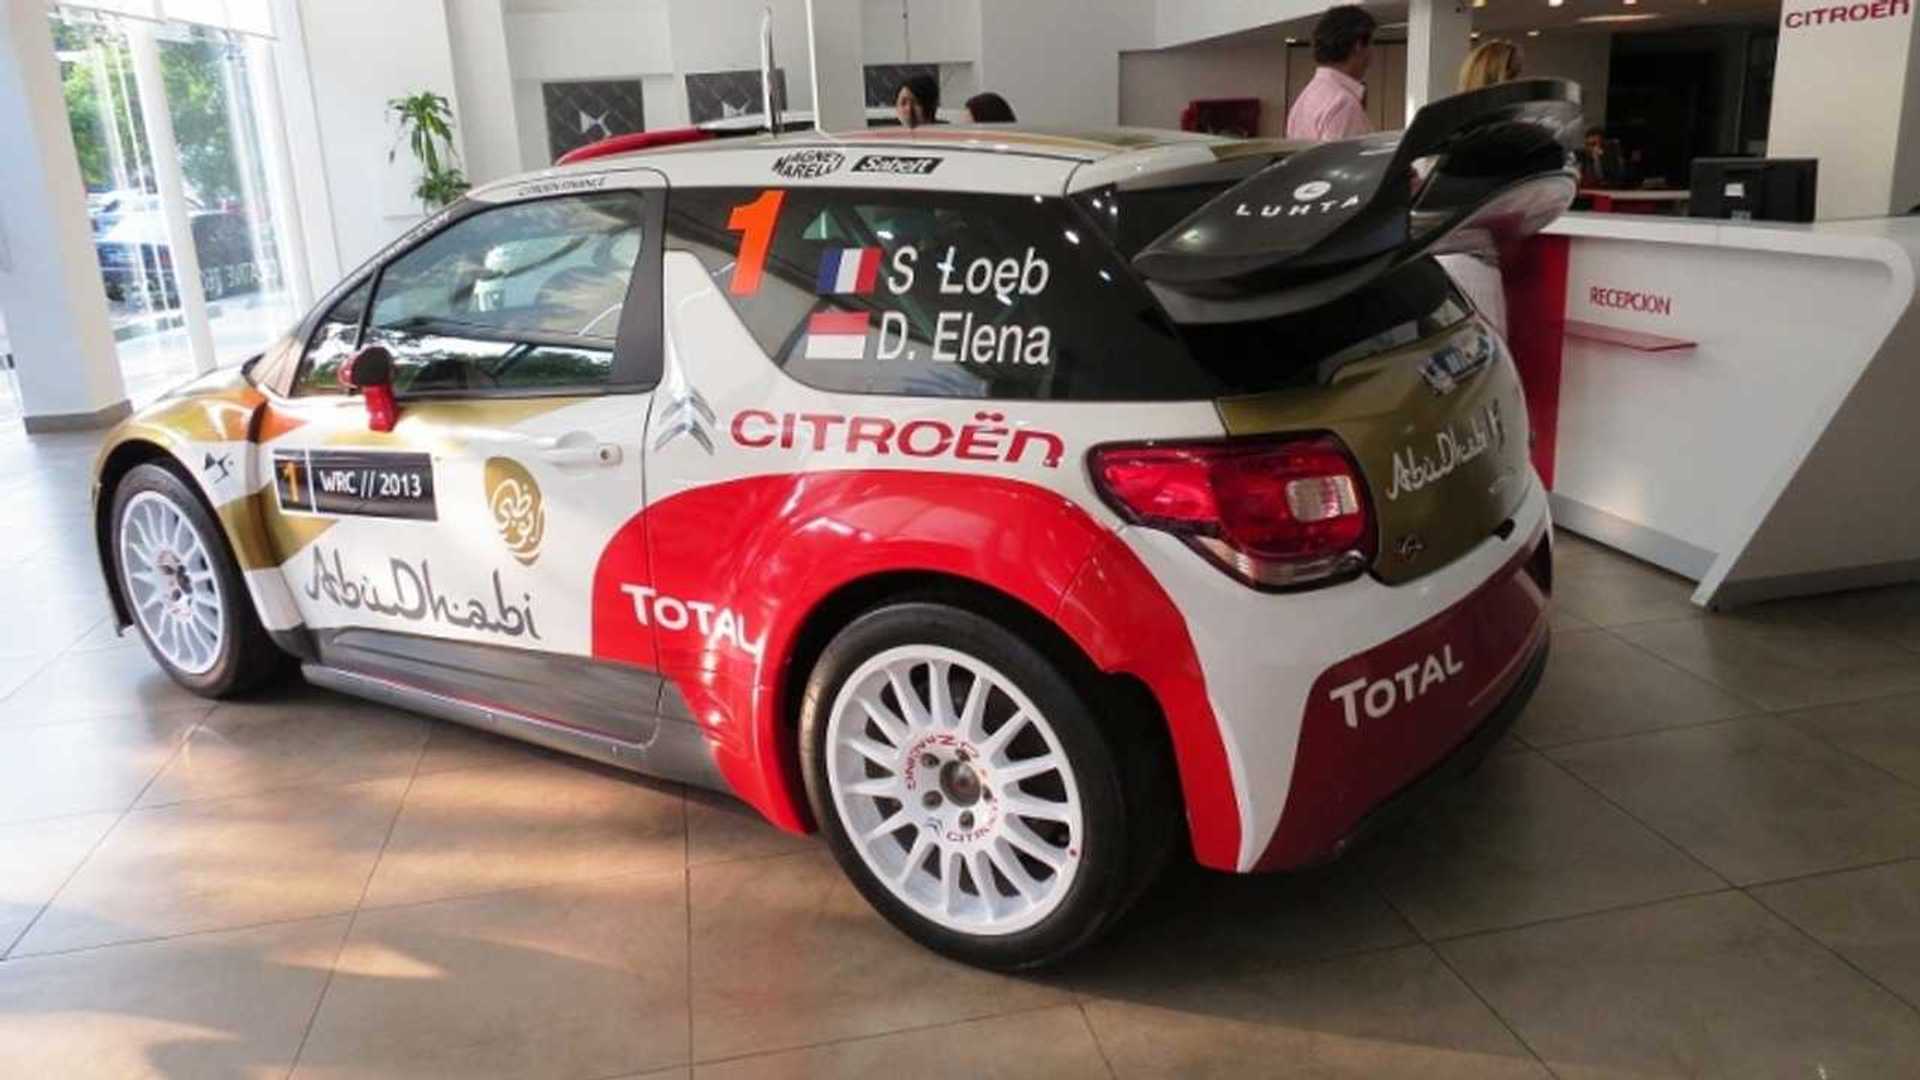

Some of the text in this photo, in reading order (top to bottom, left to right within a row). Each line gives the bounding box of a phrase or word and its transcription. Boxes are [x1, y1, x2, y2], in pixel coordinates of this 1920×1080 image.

[1235, 195, 1360, 217] LUHTA
[726, 189, 787, 296] 1
[876, 311, 1052, 366] D. Elena
[280, 459, 300, 502] 1
[319, 470, 358, 494] WRC
[379, 473, 423, 498] 2013
[620, 582, 768, 656] TOTAL
[1329, 643, 1464, 729] TOTAL
